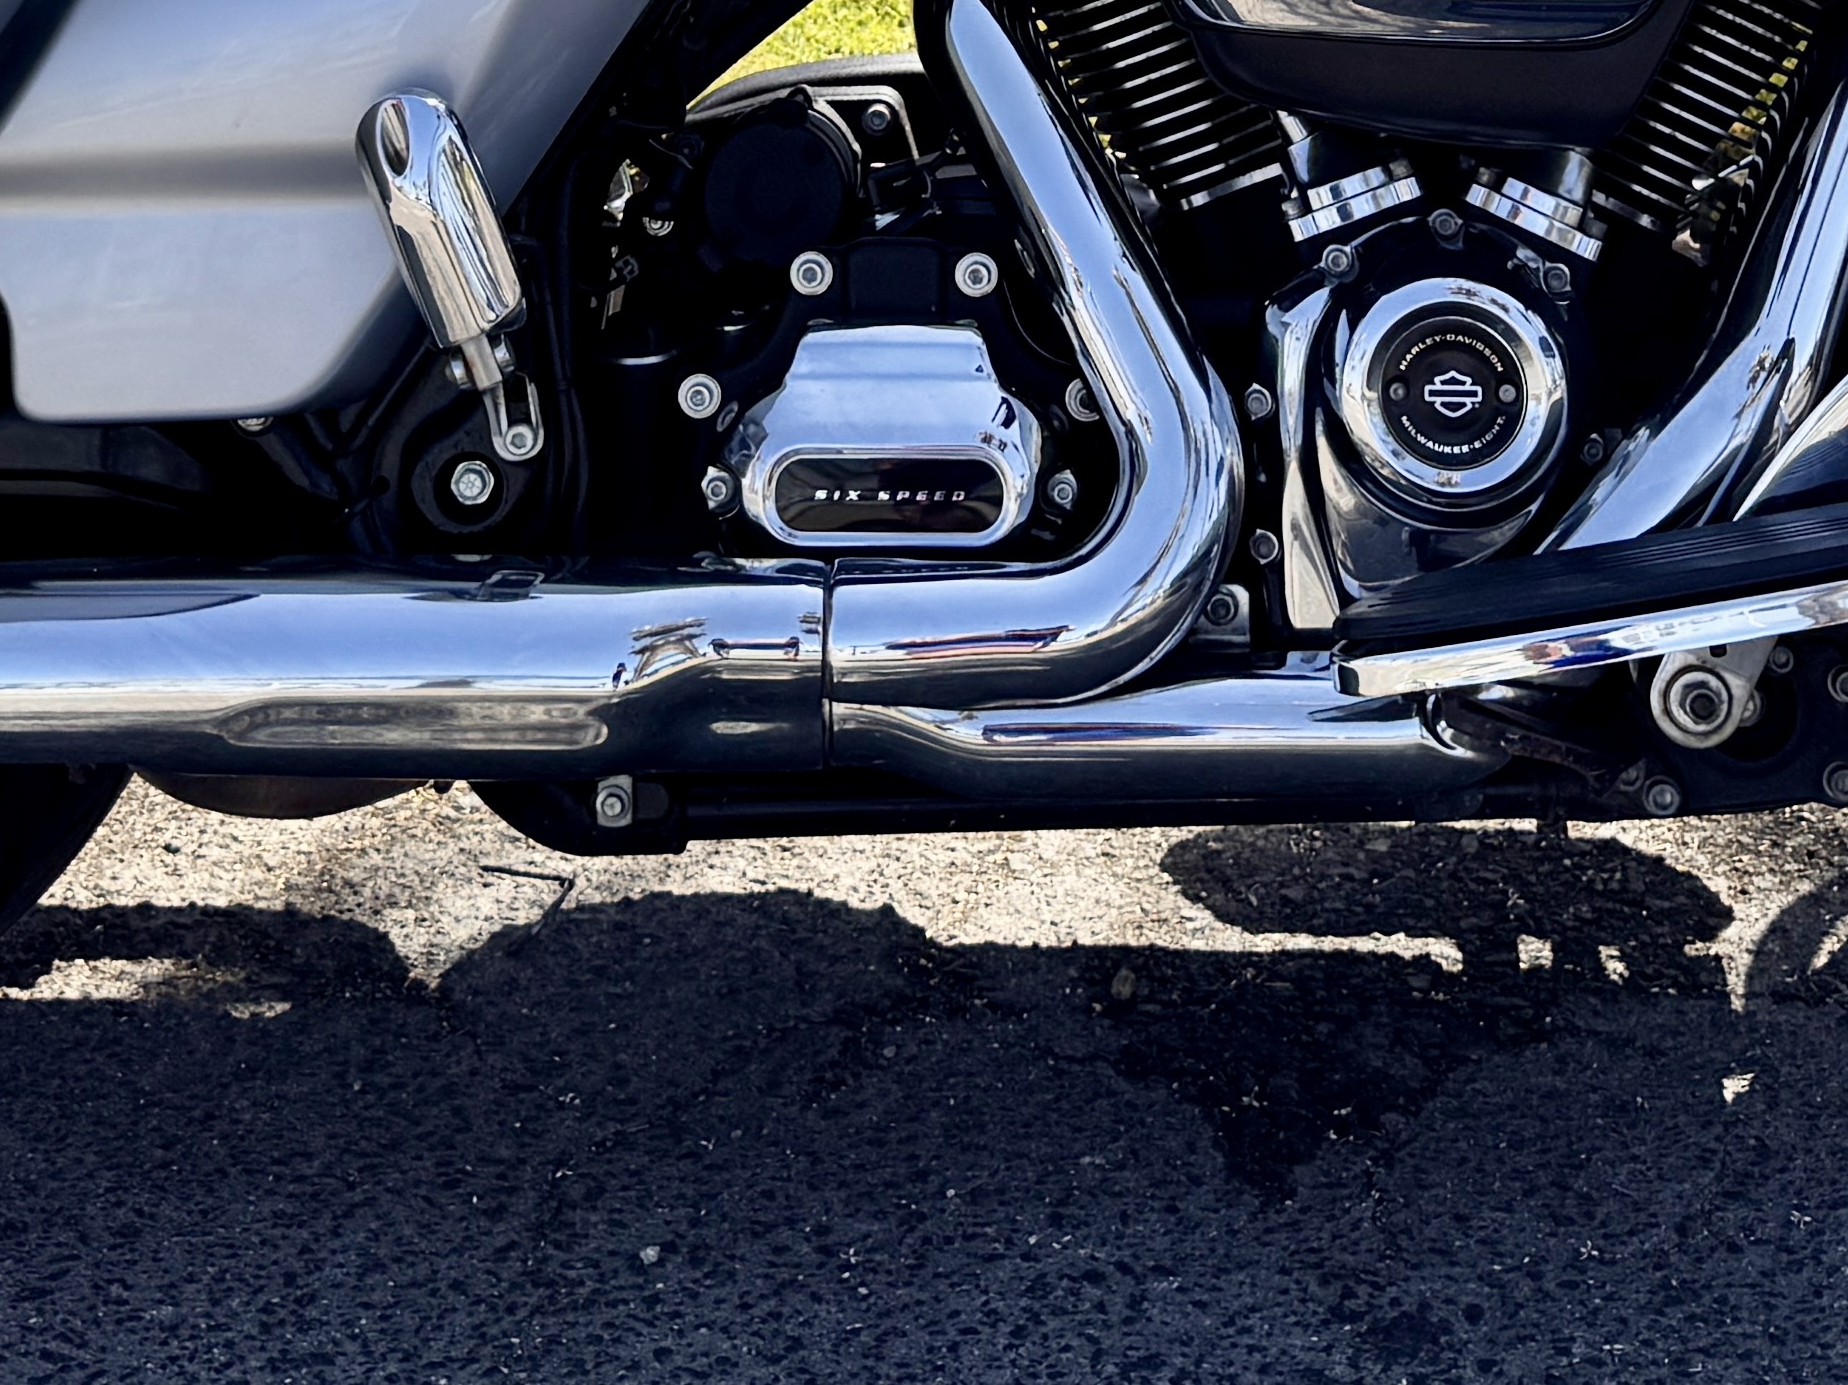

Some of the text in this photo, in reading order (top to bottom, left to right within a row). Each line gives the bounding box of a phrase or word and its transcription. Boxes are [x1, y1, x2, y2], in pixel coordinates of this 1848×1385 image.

[1399, 333, 1505, 373] HARLEY-DAVIDSON
[813, 489, 967, 502] SIX SPEED
